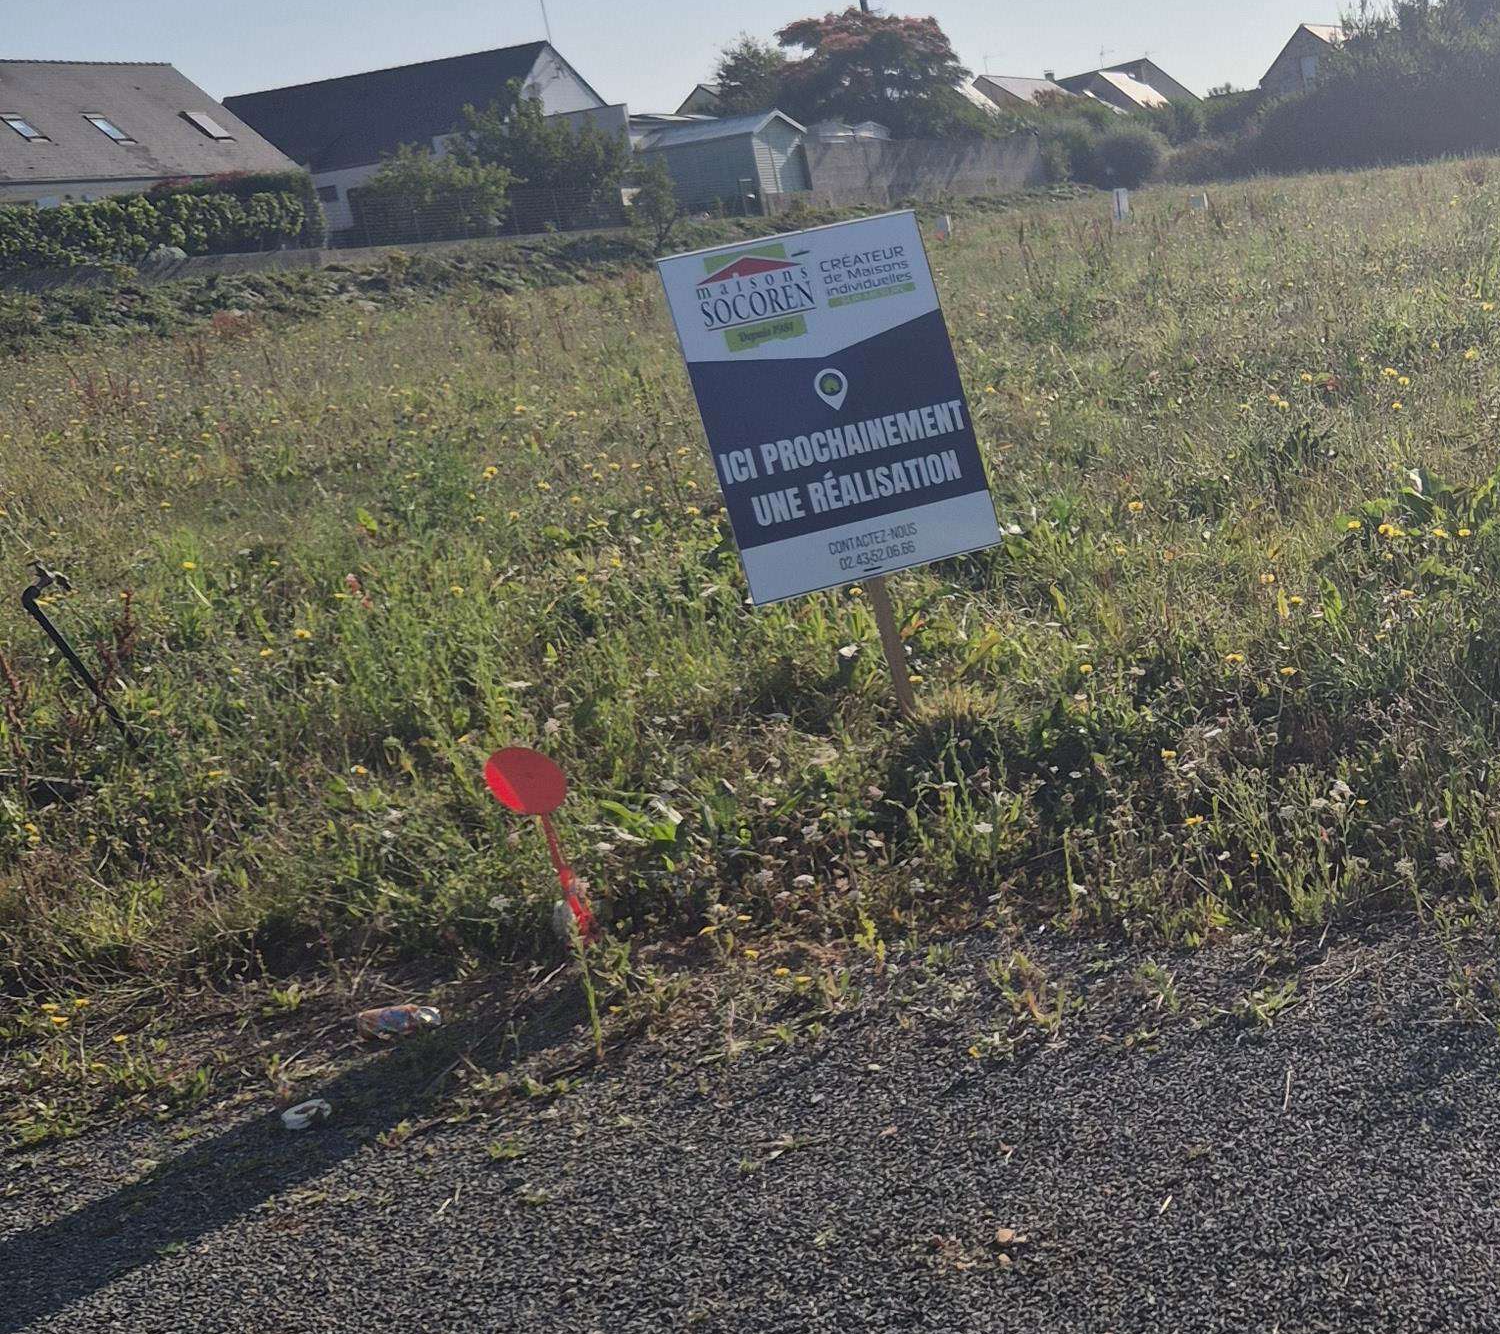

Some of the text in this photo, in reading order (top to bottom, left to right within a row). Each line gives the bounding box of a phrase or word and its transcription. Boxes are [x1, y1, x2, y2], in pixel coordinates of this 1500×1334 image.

[820, 245, 904, 272] CRÉATEUR
[823, 260, 909, 285] de Maisons
[696, 267, 808, 300] maisons
[827, 271, 913, 297] individuelles
[700, 280, 815, 327] SOCOREN
[719, 399, 966, 485] ICI PROCHAINEMENT
[751, 449, 963, 527] UNE RÉALISATION
[828, 522, 918, 555] CONTACTEZ-NOUS
